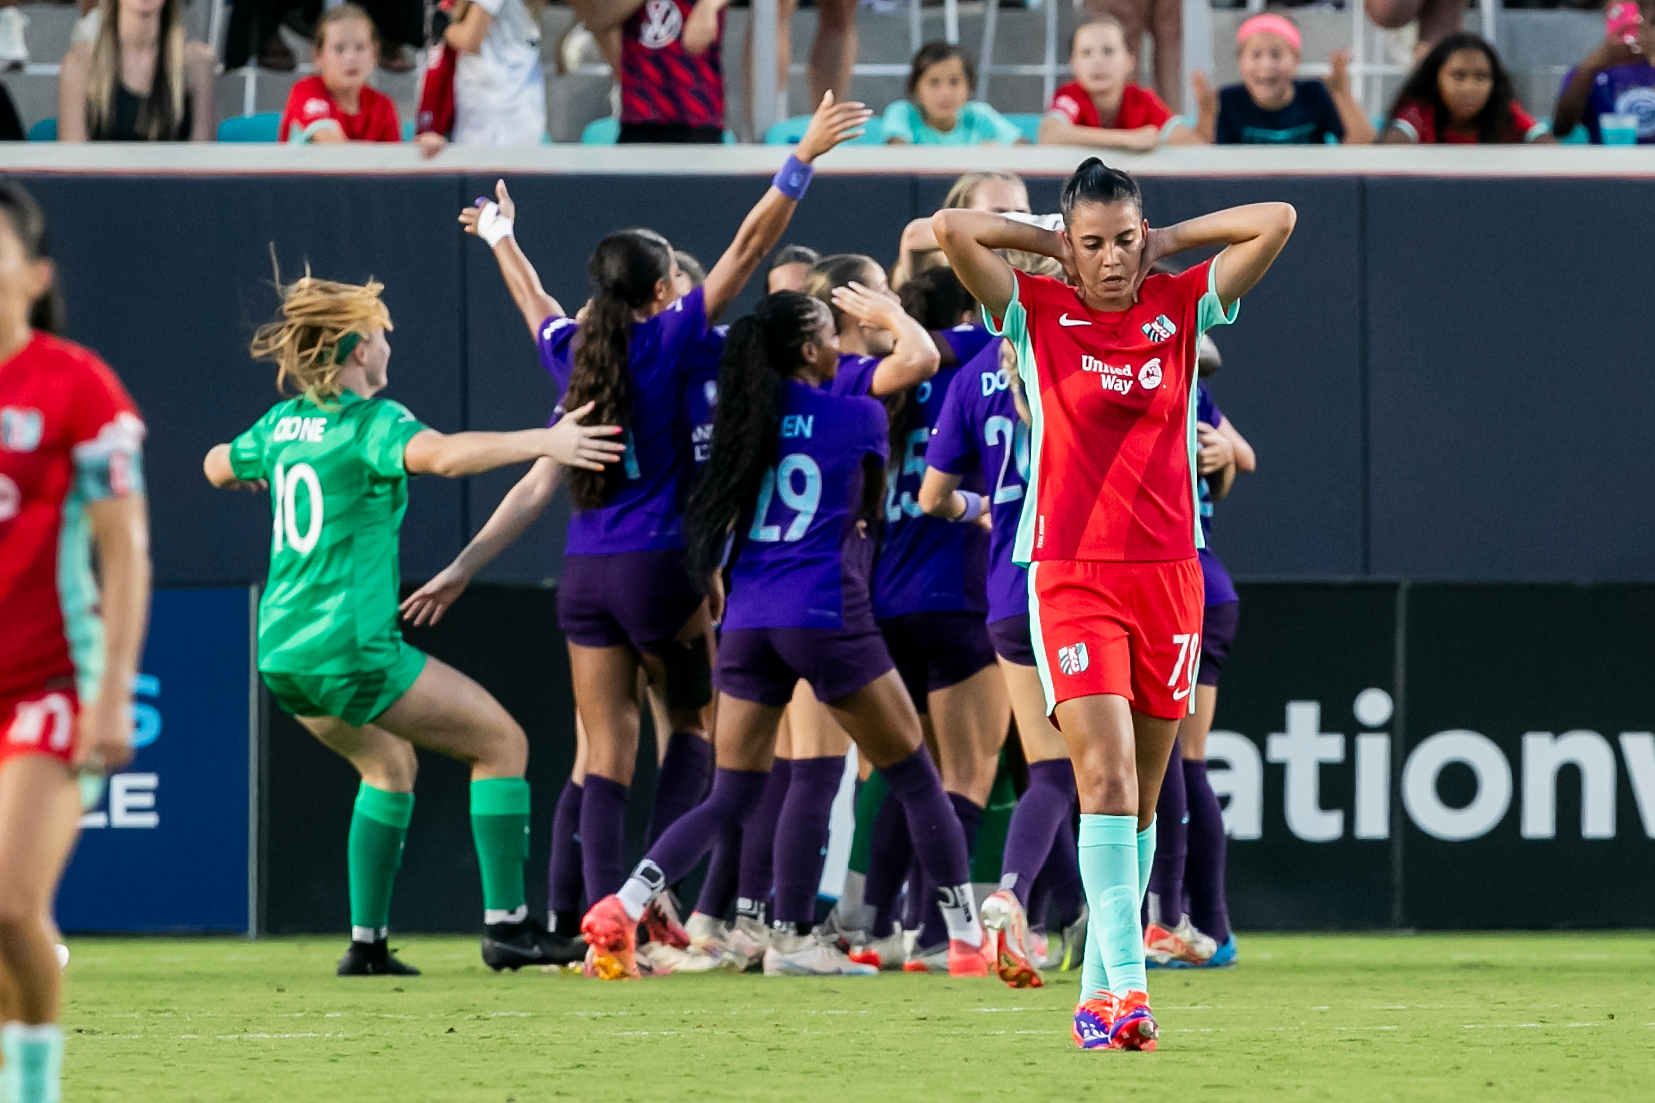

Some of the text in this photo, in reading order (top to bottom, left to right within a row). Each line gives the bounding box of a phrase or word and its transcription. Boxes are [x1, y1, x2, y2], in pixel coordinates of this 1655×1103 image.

[1081, 354, 1133, 377] United
[1100, 373, 1133, 395] Way
[781, 414, 814, 438] EN
[1203, 687, 1655, 842] ation
